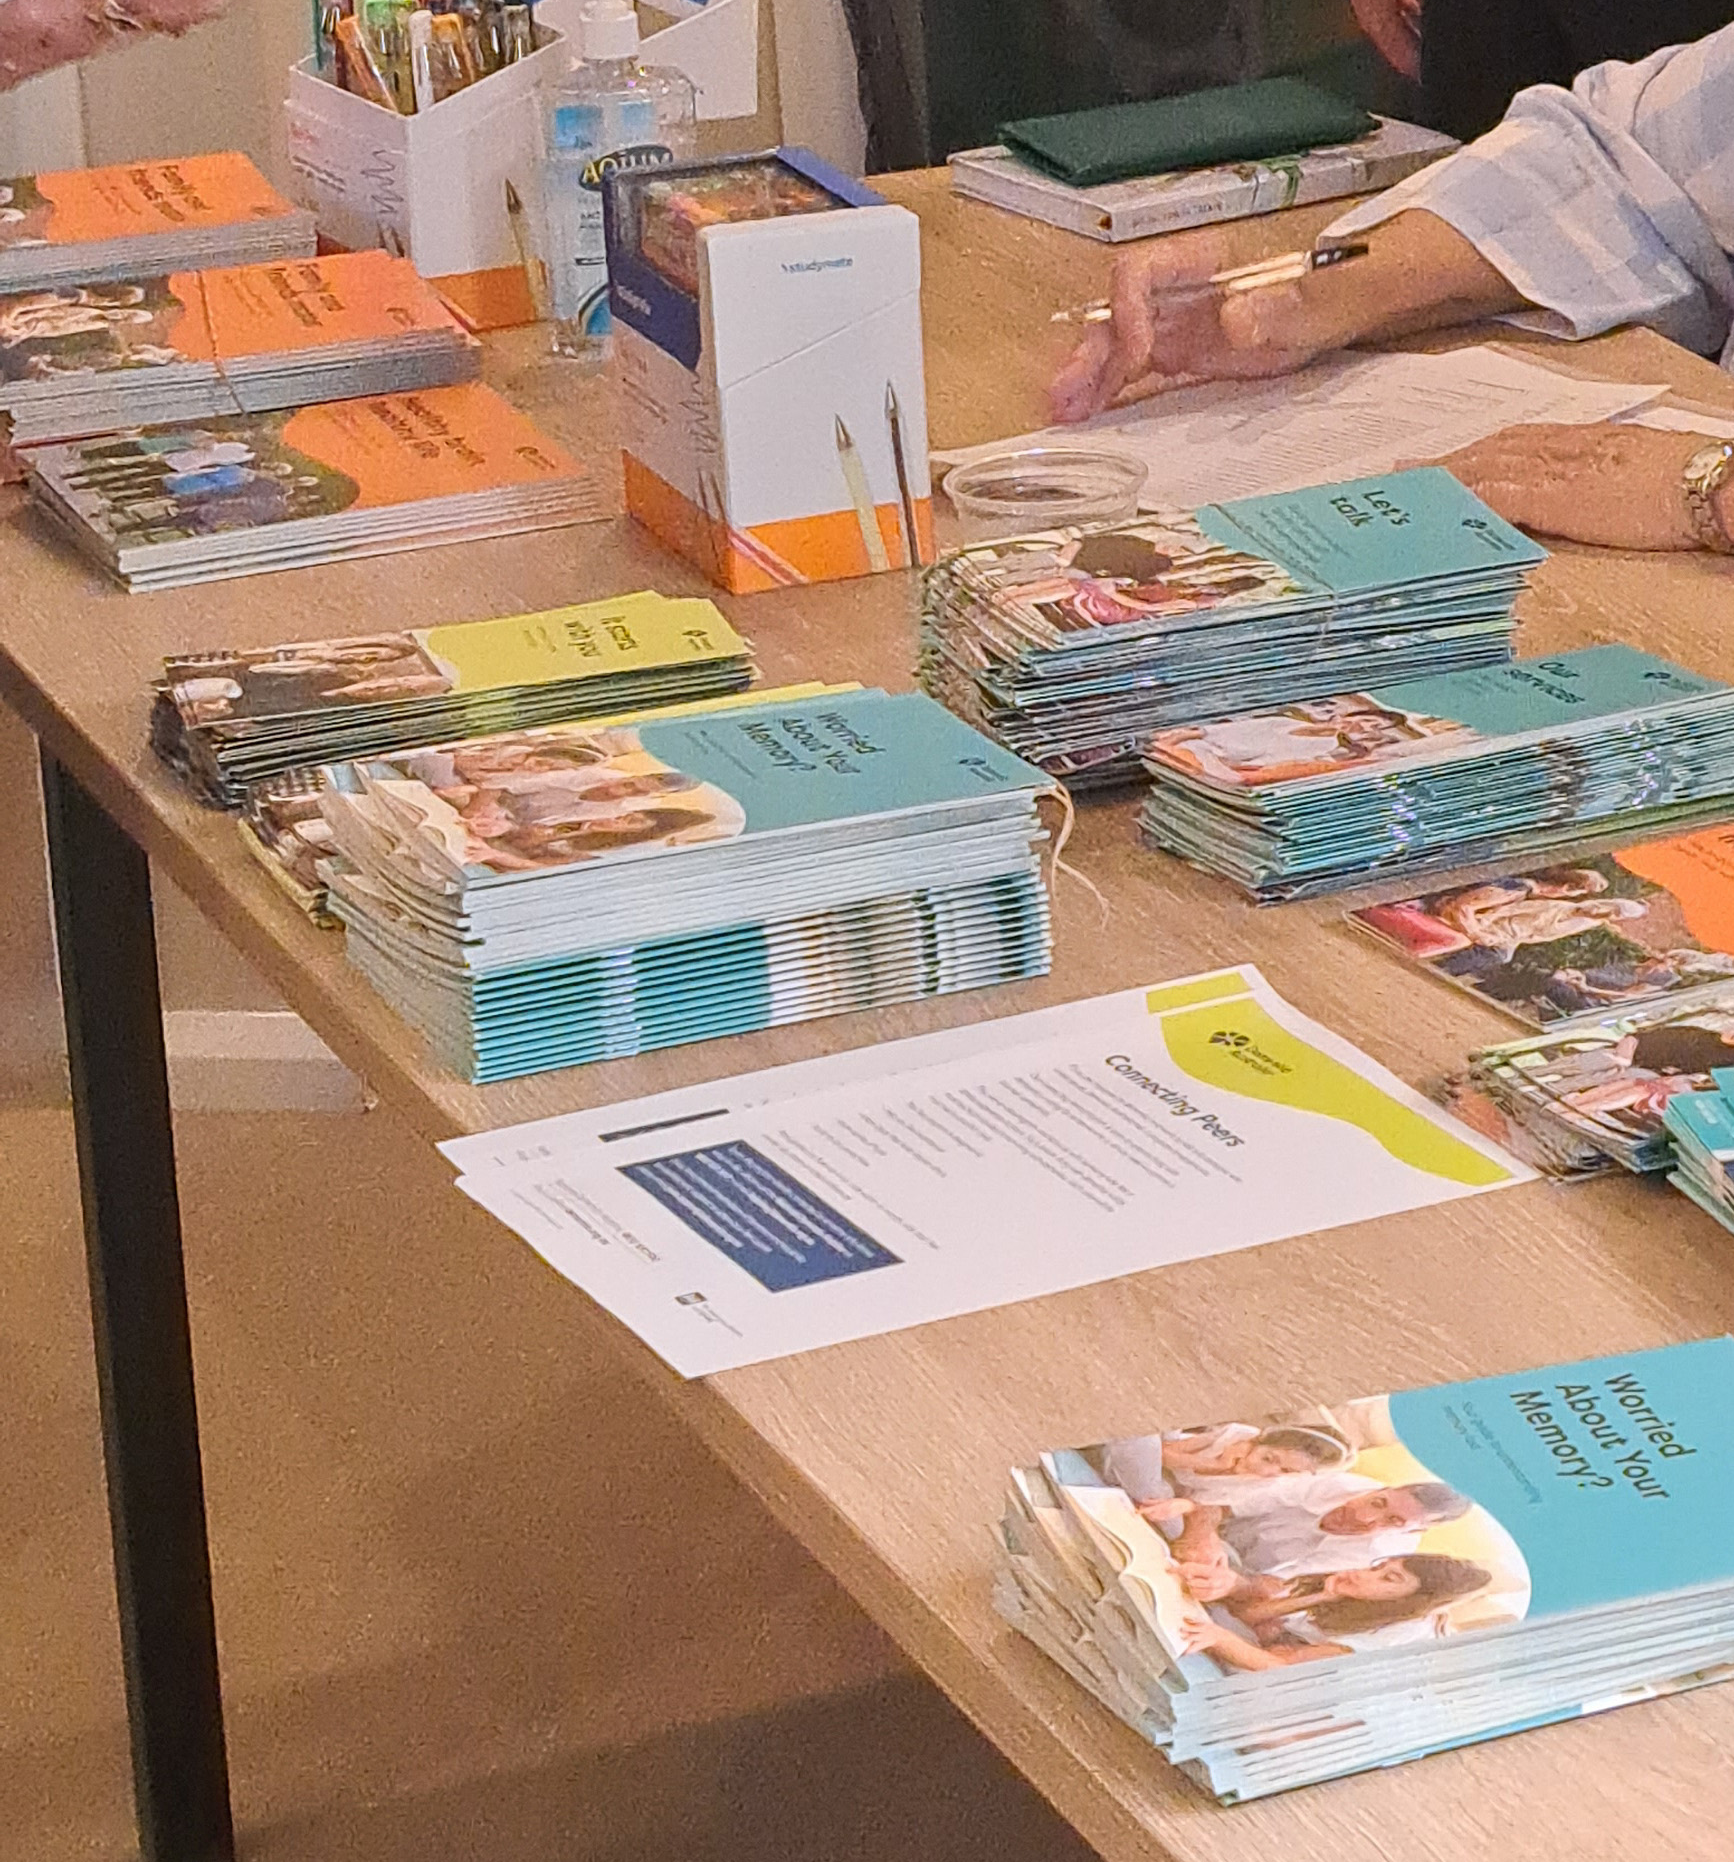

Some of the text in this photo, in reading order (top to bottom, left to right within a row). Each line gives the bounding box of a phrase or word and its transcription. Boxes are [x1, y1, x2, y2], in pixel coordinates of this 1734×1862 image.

[1330, 496, 1375, 528] talk
[1362, 489, 1411, 527] Let's
[736, 720, 818, 773] Memory?
[776, 716, 832, 754] About
[1104, 1054, 1246, 1148] Connecting Peers
[1509, 1390, 1615, 1490] Memory?
[1554, 1383, 1670, 1499] About Your
[1603, 1372, 1698, 1459] Worried
